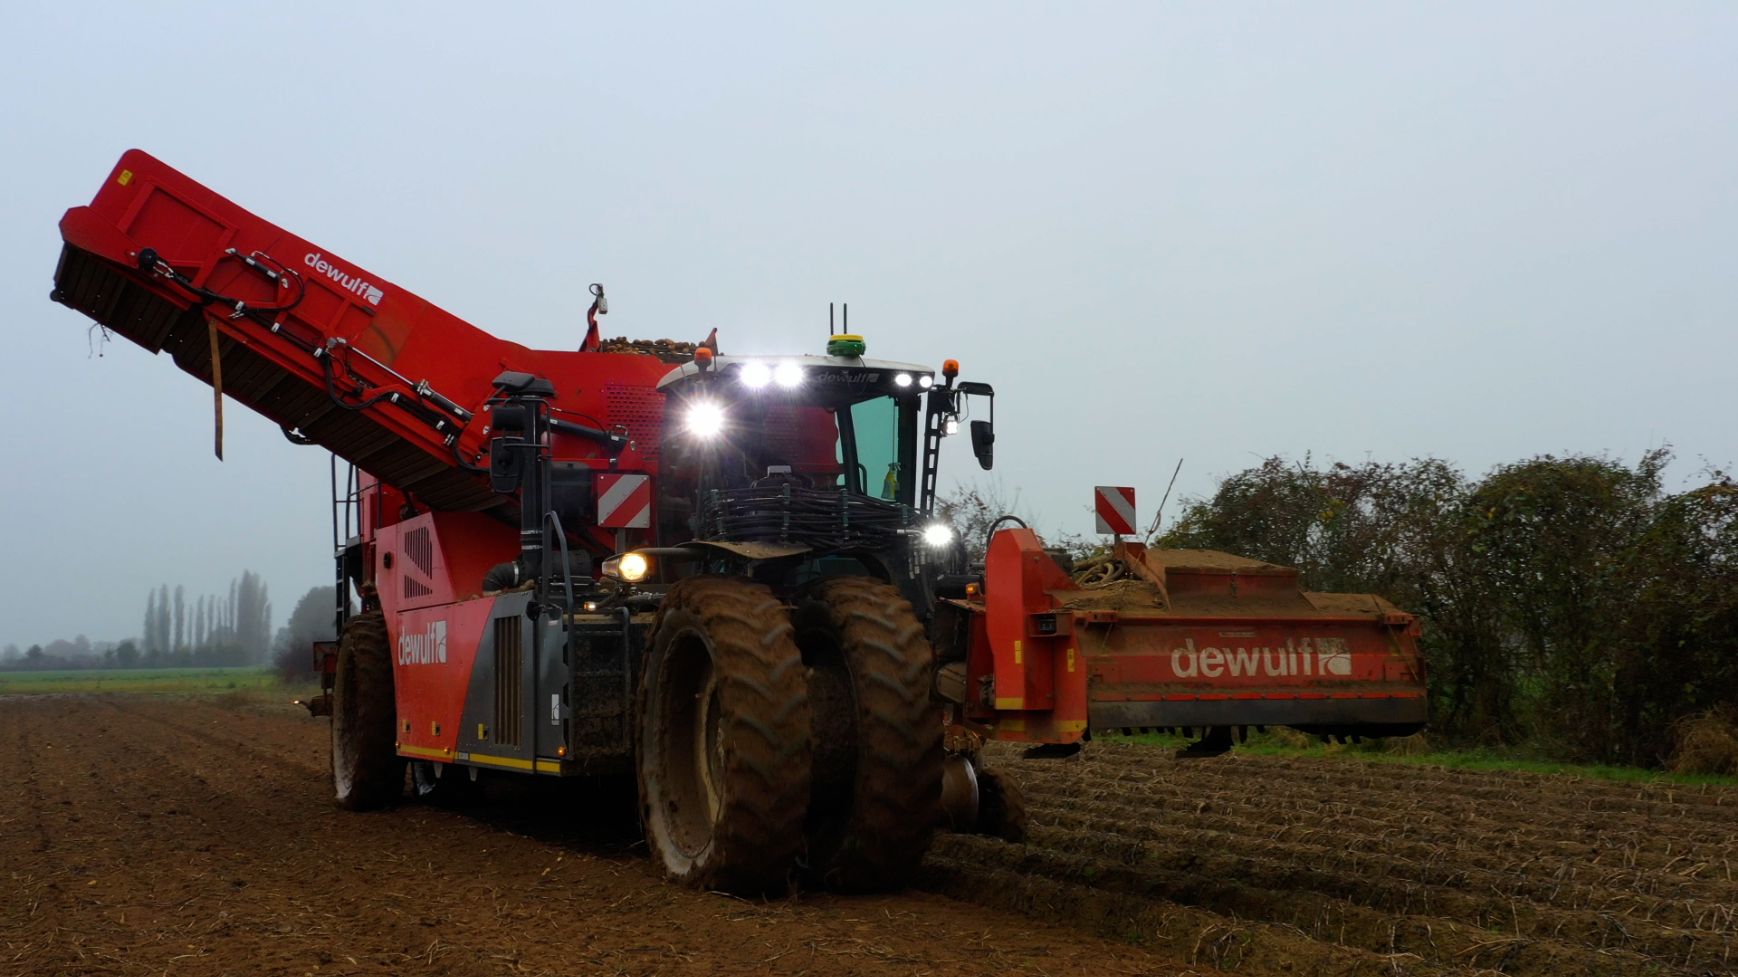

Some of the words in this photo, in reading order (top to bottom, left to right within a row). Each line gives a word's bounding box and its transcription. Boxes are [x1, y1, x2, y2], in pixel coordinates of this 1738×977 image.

[304, 252, 369, 299] dewulf
[398, 621, 436, 665] dewulf
[1171, 637, 1314, 678] dewulf
